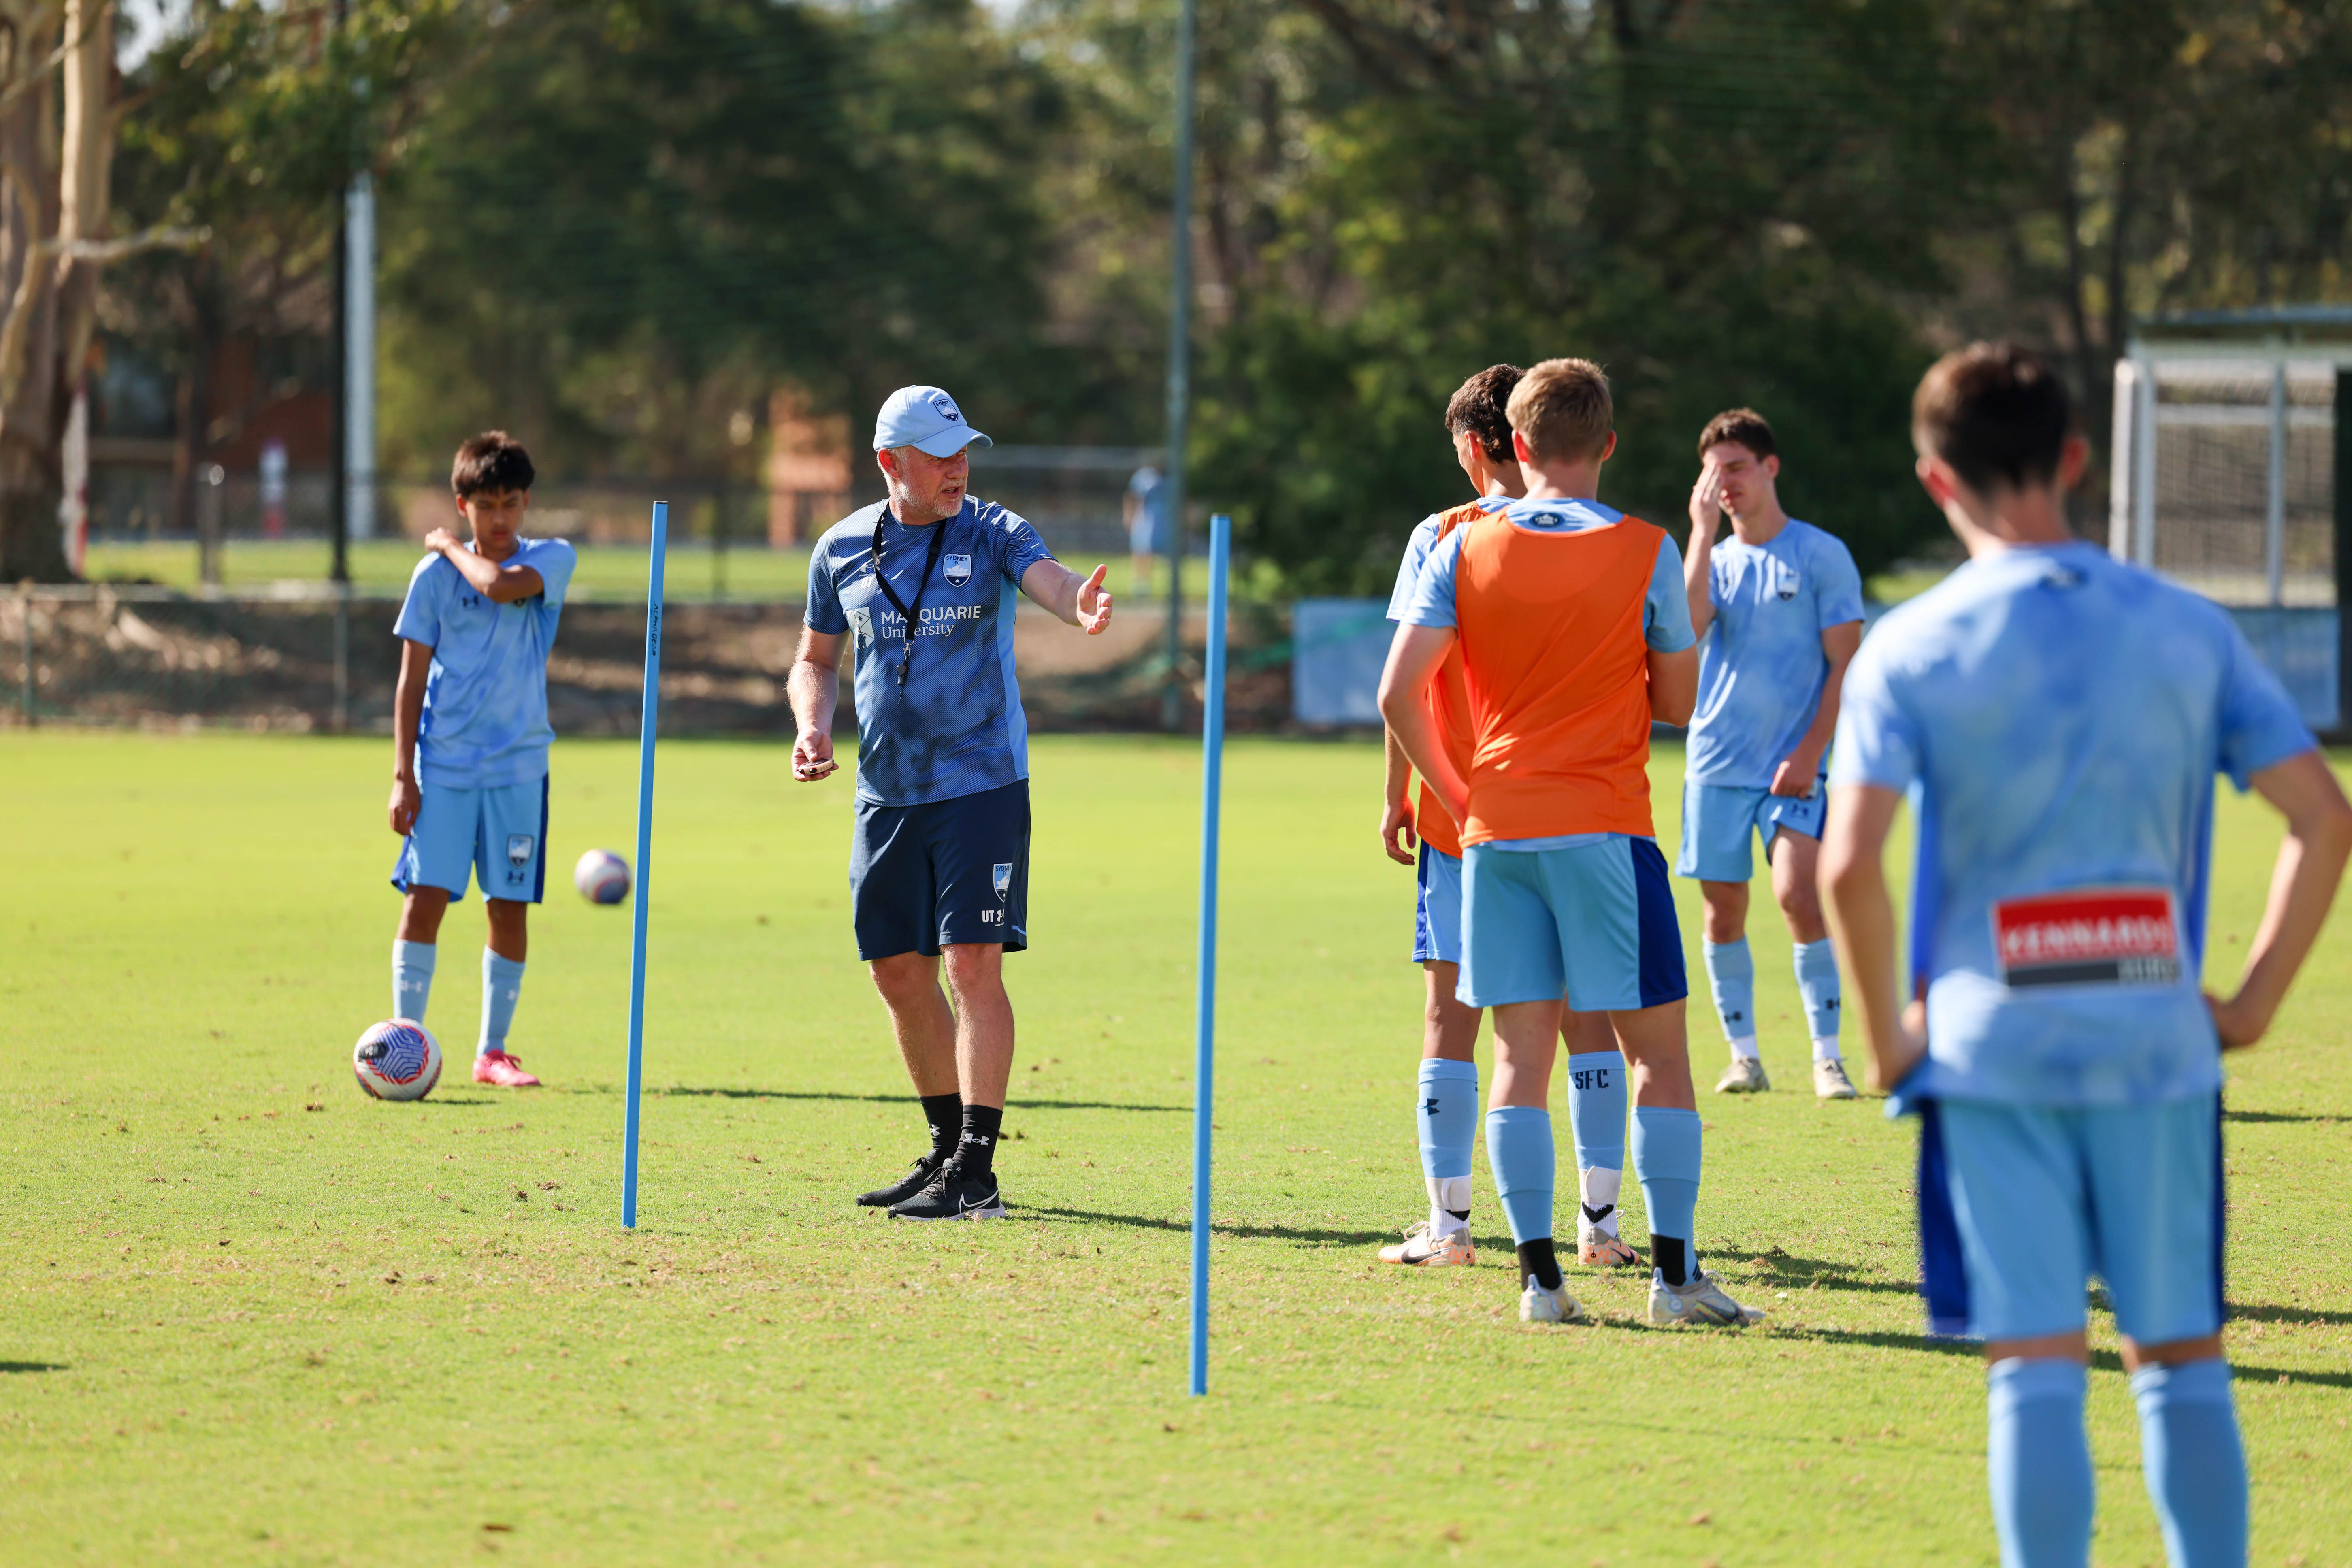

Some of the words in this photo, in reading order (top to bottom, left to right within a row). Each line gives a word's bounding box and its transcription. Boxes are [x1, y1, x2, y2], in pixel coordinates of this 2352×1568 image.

[881, 605, 981, 624] MAQUARIE
[881, 623, 955, 639] Uniersity
[982, 910, 995, 923] UT
[1575, 1069, 1609, 1089] SFC
